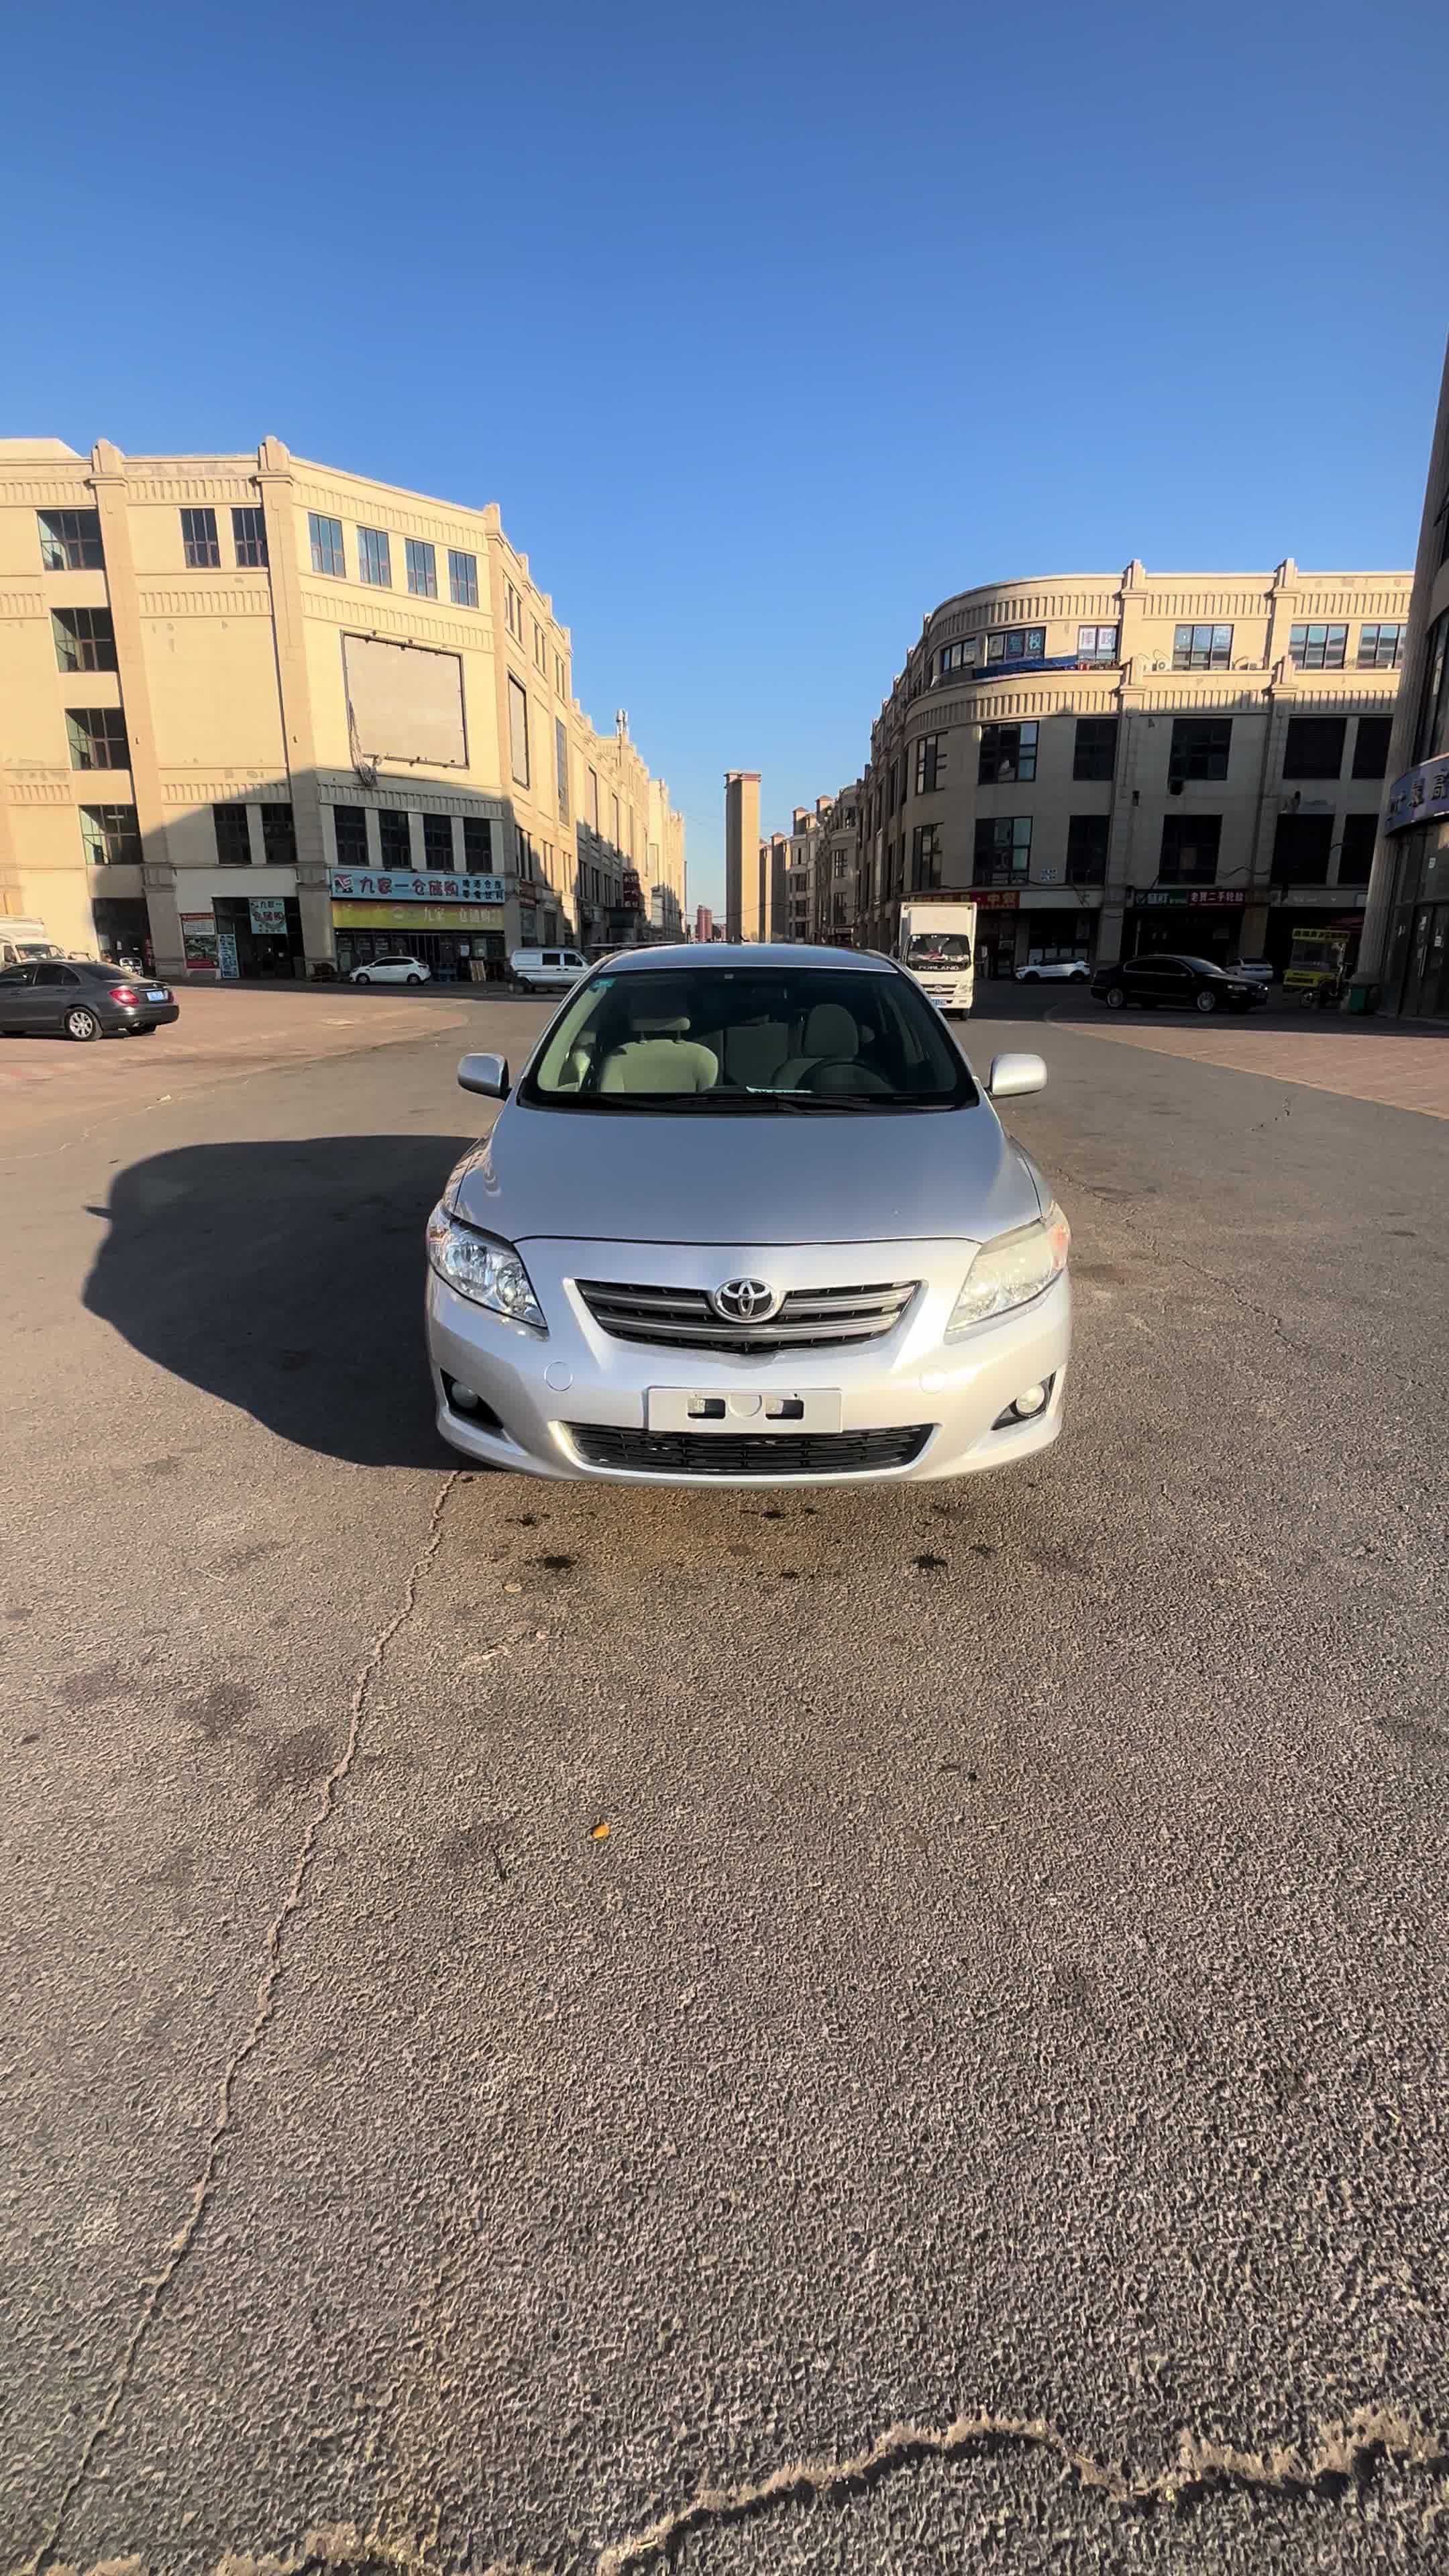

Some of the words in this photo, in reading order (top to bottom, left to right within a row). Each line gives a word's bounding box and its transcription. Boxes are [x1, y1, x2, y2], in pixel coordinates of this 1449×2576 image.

[360, 875, 459, 897] 九家一仓储购
